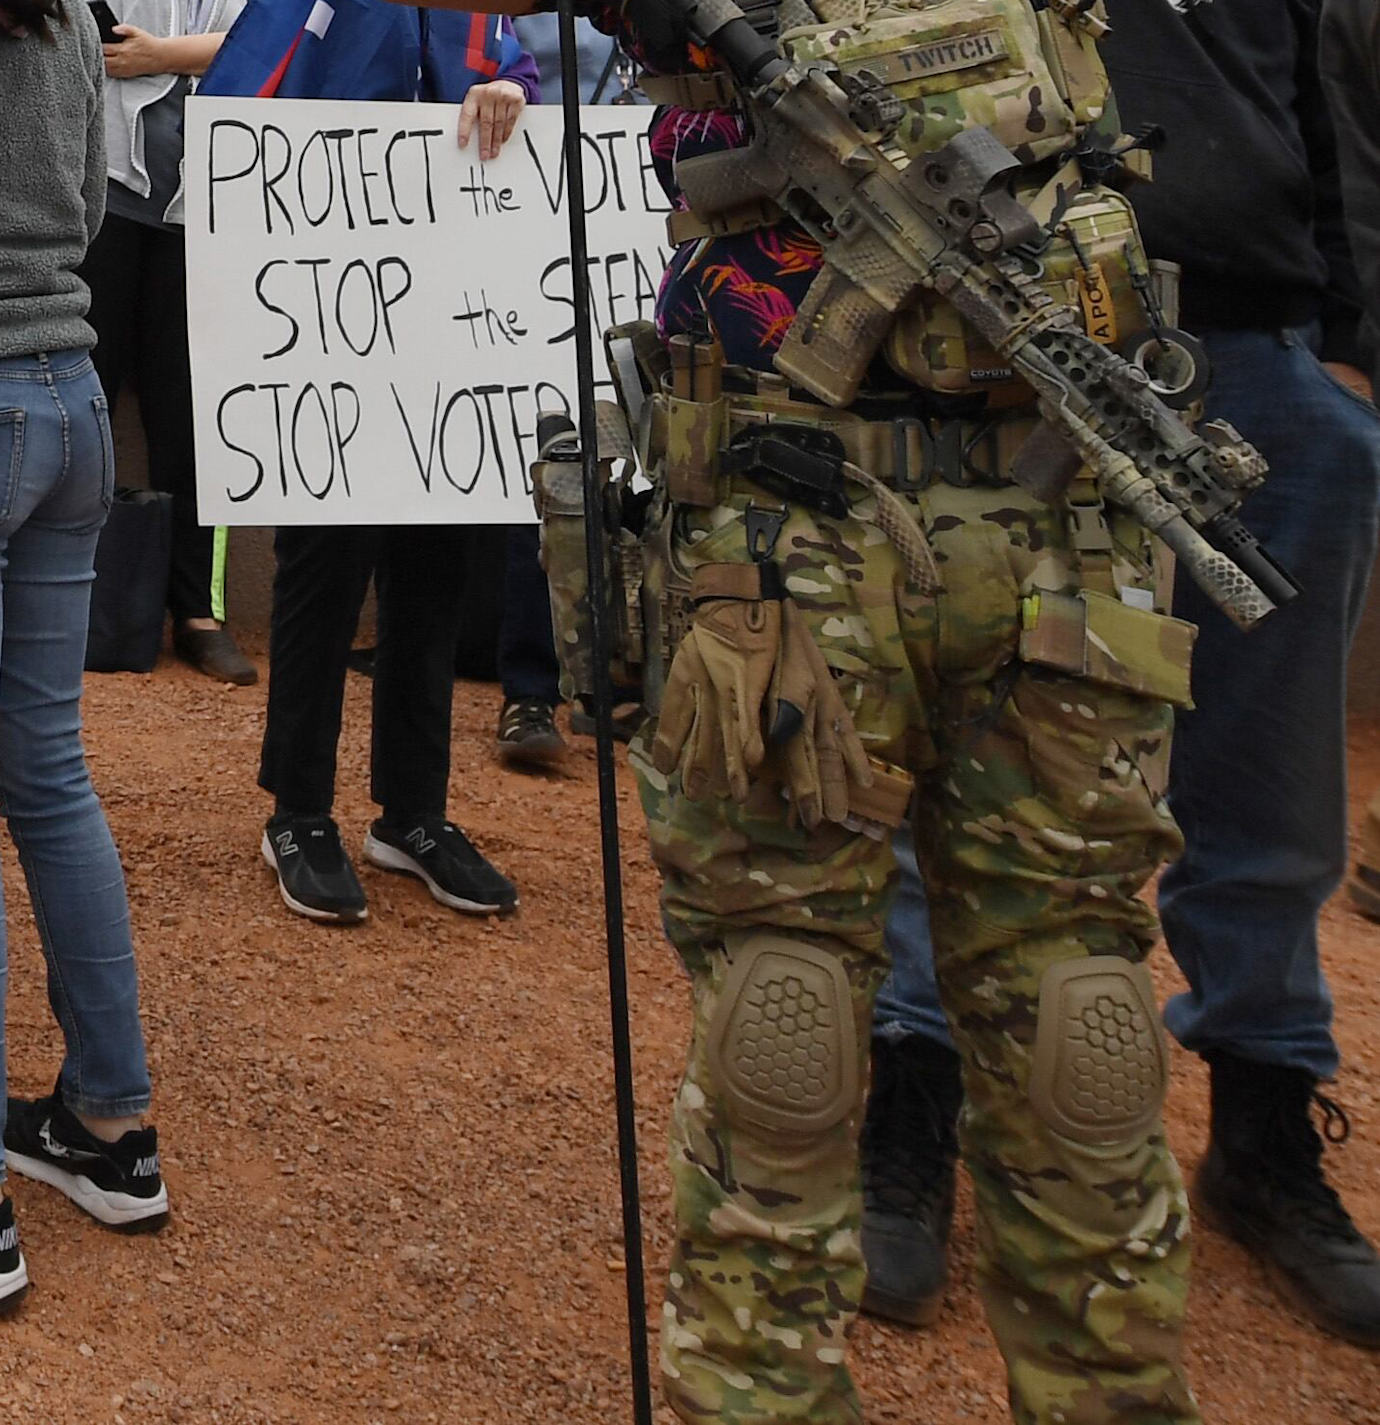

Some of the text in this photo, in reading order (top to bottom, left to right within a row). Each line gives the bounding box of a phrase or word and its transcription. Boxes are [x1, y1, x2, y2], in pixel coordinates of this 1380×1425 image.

[897, 36, 993, 72] TWITCH
[208, 119, 444, 236] PROTECT
[459, 159, 521, 218] the
[256, 246, 670, 360] STOP the STEA
[216, 380, 360, 502] STOP
[132, 1154, 160, 1176] NIK
